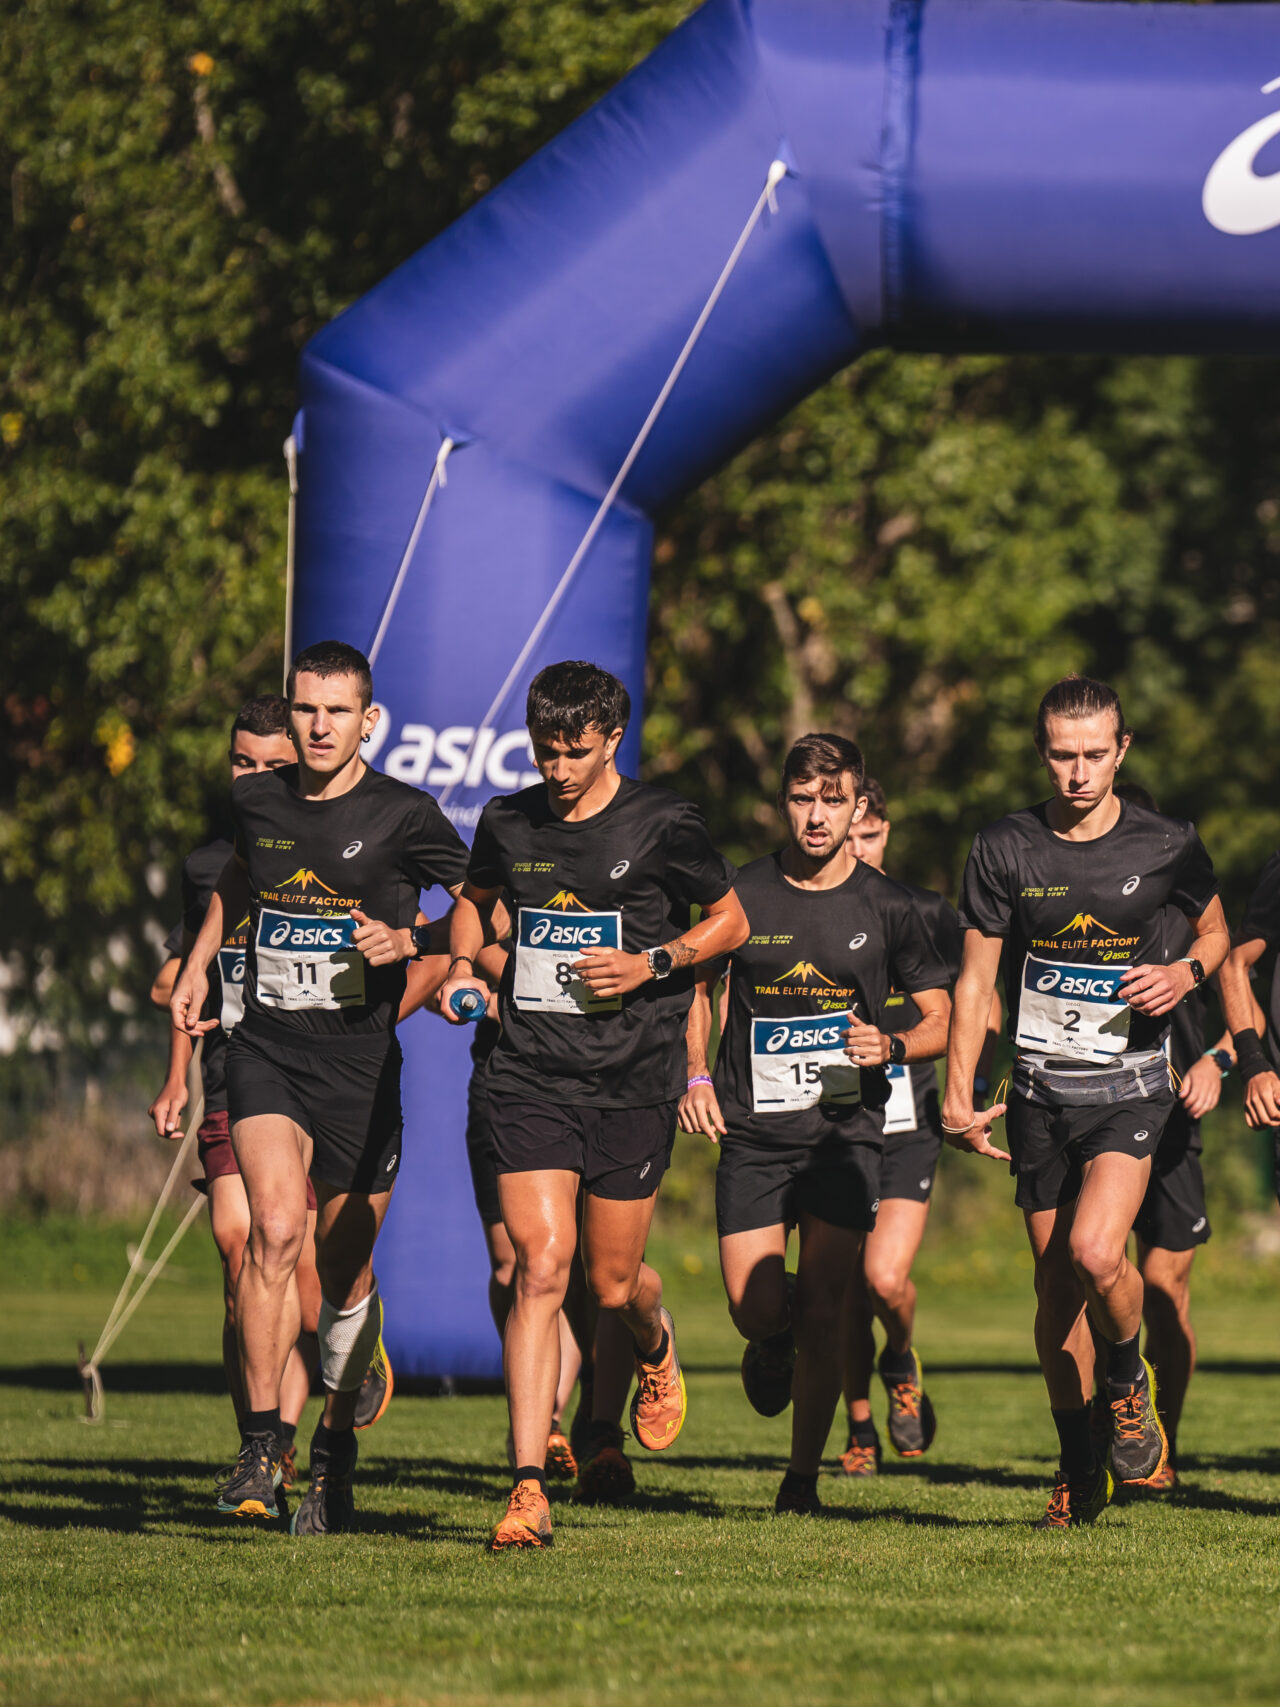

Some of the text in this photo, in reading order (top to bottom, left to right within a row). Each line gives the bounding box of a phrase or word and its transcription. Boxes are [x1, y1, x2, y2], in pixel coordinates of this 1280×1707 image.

[260, 891, 362, 908] TRAIL ELITE FACTORY
[1032, 937, 1140, 949] TRAIL ELITE FACTORY
[293, 962, 317, 985] 11
[555, 962, 572, 986] 8
[755, 986, 856, 998] TRAIL ELITE FACTORY
[1063, 1009, 1081, 1033] 2
[790, 1062, 822, 1085] 15
